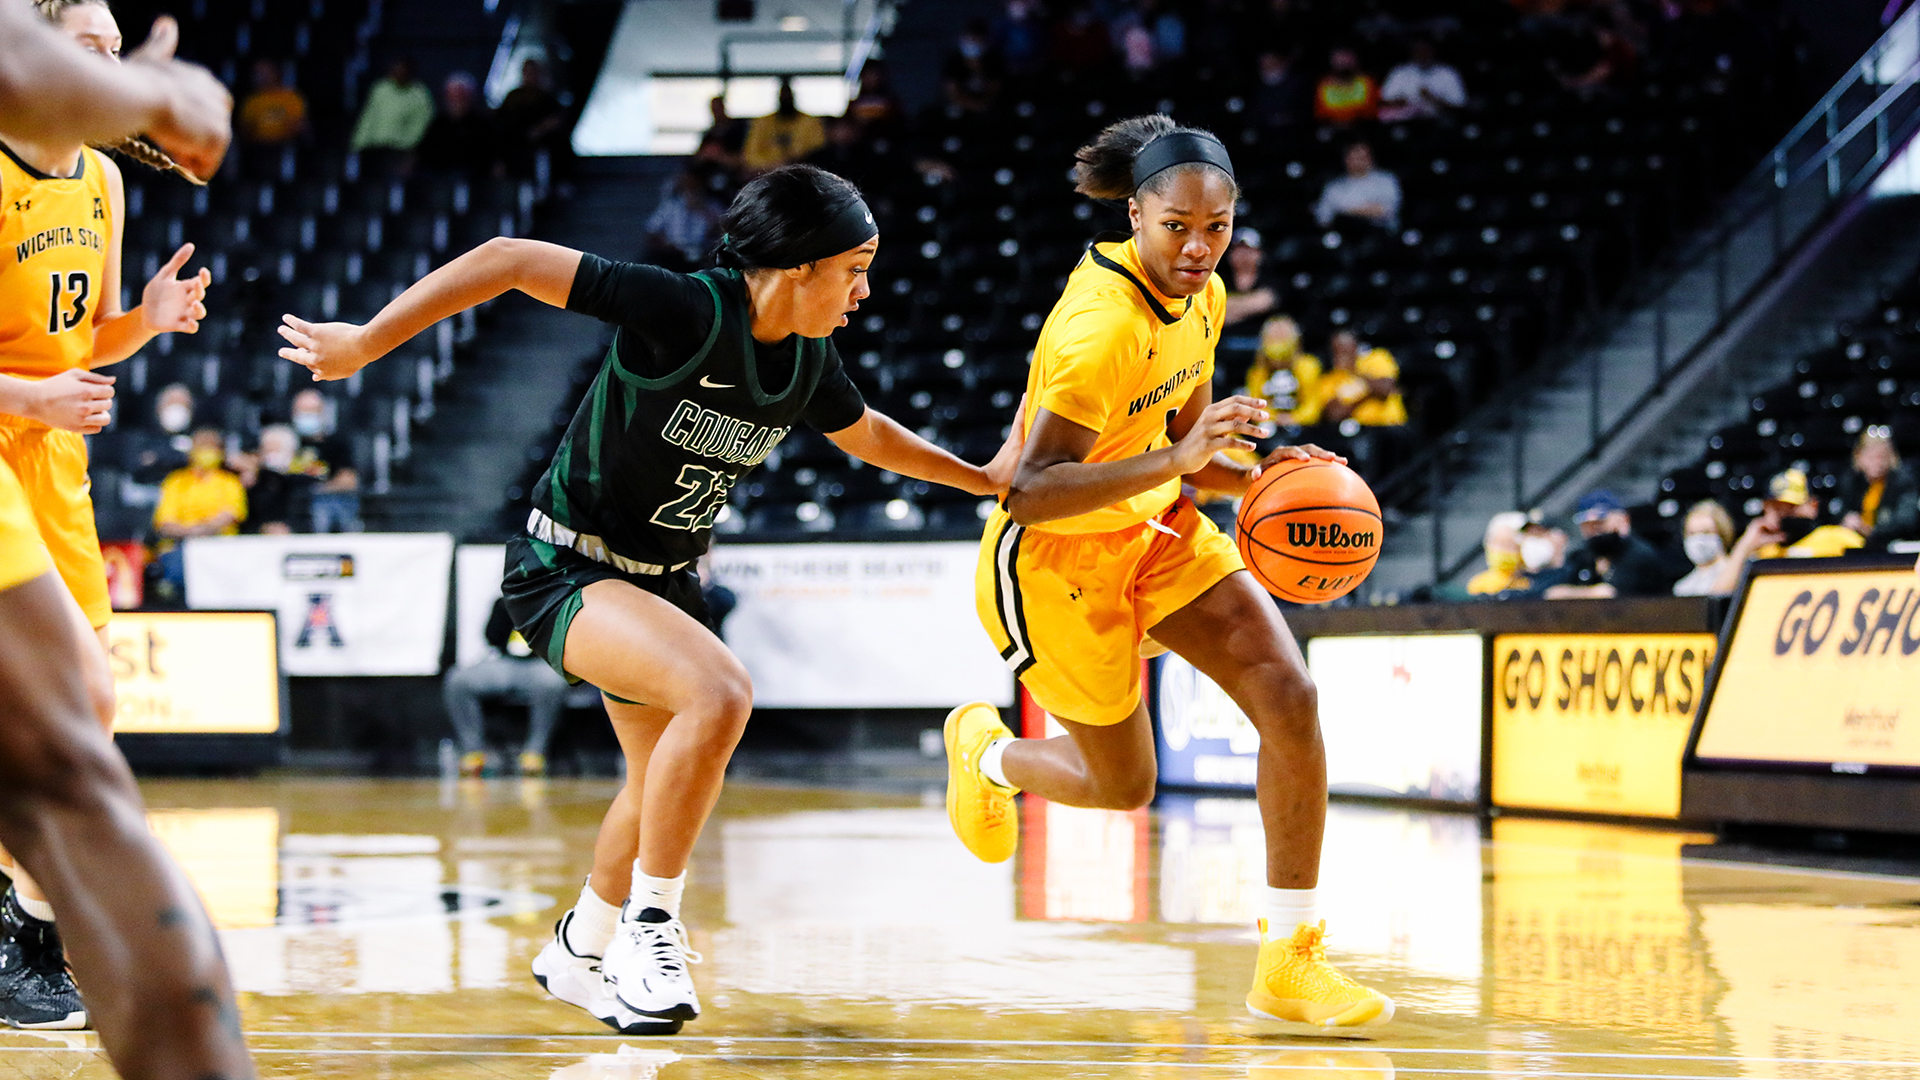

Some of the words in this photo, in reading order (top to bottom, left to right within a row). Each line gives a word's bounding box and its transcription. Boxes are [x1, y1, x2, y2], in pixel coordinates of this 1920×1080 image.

[16, 226, 74, 264] WICHITA
[48, 271, 89, 335] 13
[1127, 368, 1187, 417] WICHITA
[1286, 522, 1374, 549] Wilson
[1774, 589, 1840, 656] GO
[109, 630, 168, 680] st
[1502, 649, 1547, 710] GO
